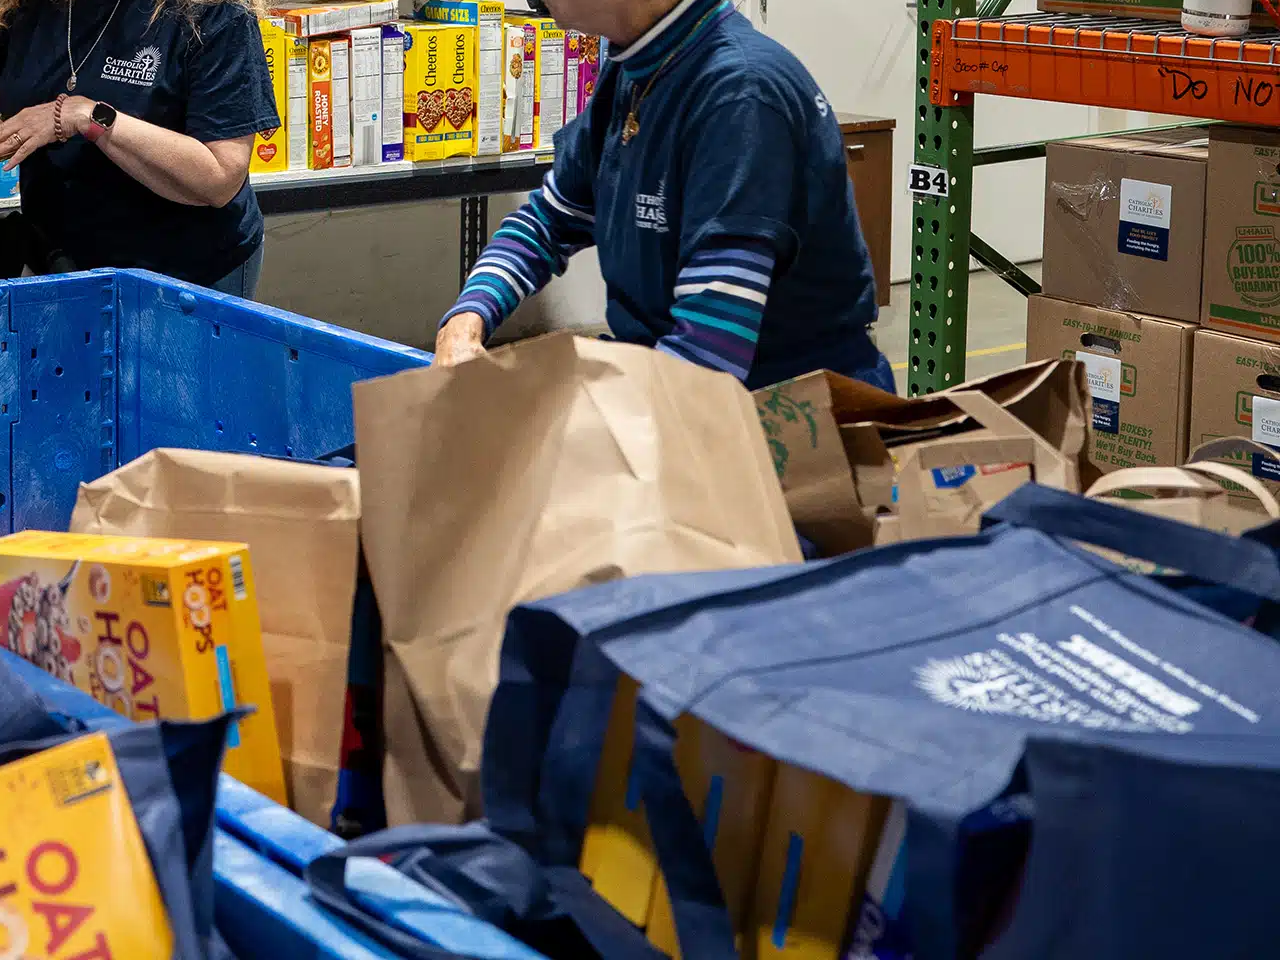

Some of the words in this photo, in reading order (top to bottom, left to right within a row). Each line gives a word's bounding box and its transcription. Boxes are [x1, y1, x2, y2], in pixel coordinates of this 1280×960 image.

[425, 6, 449, 21] GIANT
[450, 7, 469, 22] SIZE
[480, 4, 501, 13] Cheerios
[106, 56, 145, 70] CATHOLIC
[424, 35, 437, 87] Cheerios
[453, 34, 465, 85] Cheerios
[103, 64, 156, 80] CHARITIES
[1234, 76, 1280, 107] NO
[909, 169, 947, 193] B4
[1128, 198, 1153, 208] CATHOLIC
[1128, 204, 1163, 216] CHARITIES
[1233, 265, 1280, 280] BUY-BAC
[1235, 280, 1280, 294] GUARANT
[1063, 319, 1108, 335] EASY-TO-LIFT
[1109, 328, 1141, 343] HANDLES
[1121, 423, 1152, 437] BOXES?
[1118, 433, 1152, 451] PLENTY!
[1096, 443, 1116, 453] We'll
[1119, 446, 1133, 458] Buy
[1136, 451, 1157, 464] Back
[1096, 451, 1109, 463] the
[207, 567, 228, 613] OAT
[184, 569, 215, 655] HOOPS
[127, 621, 159, 721] OAT
